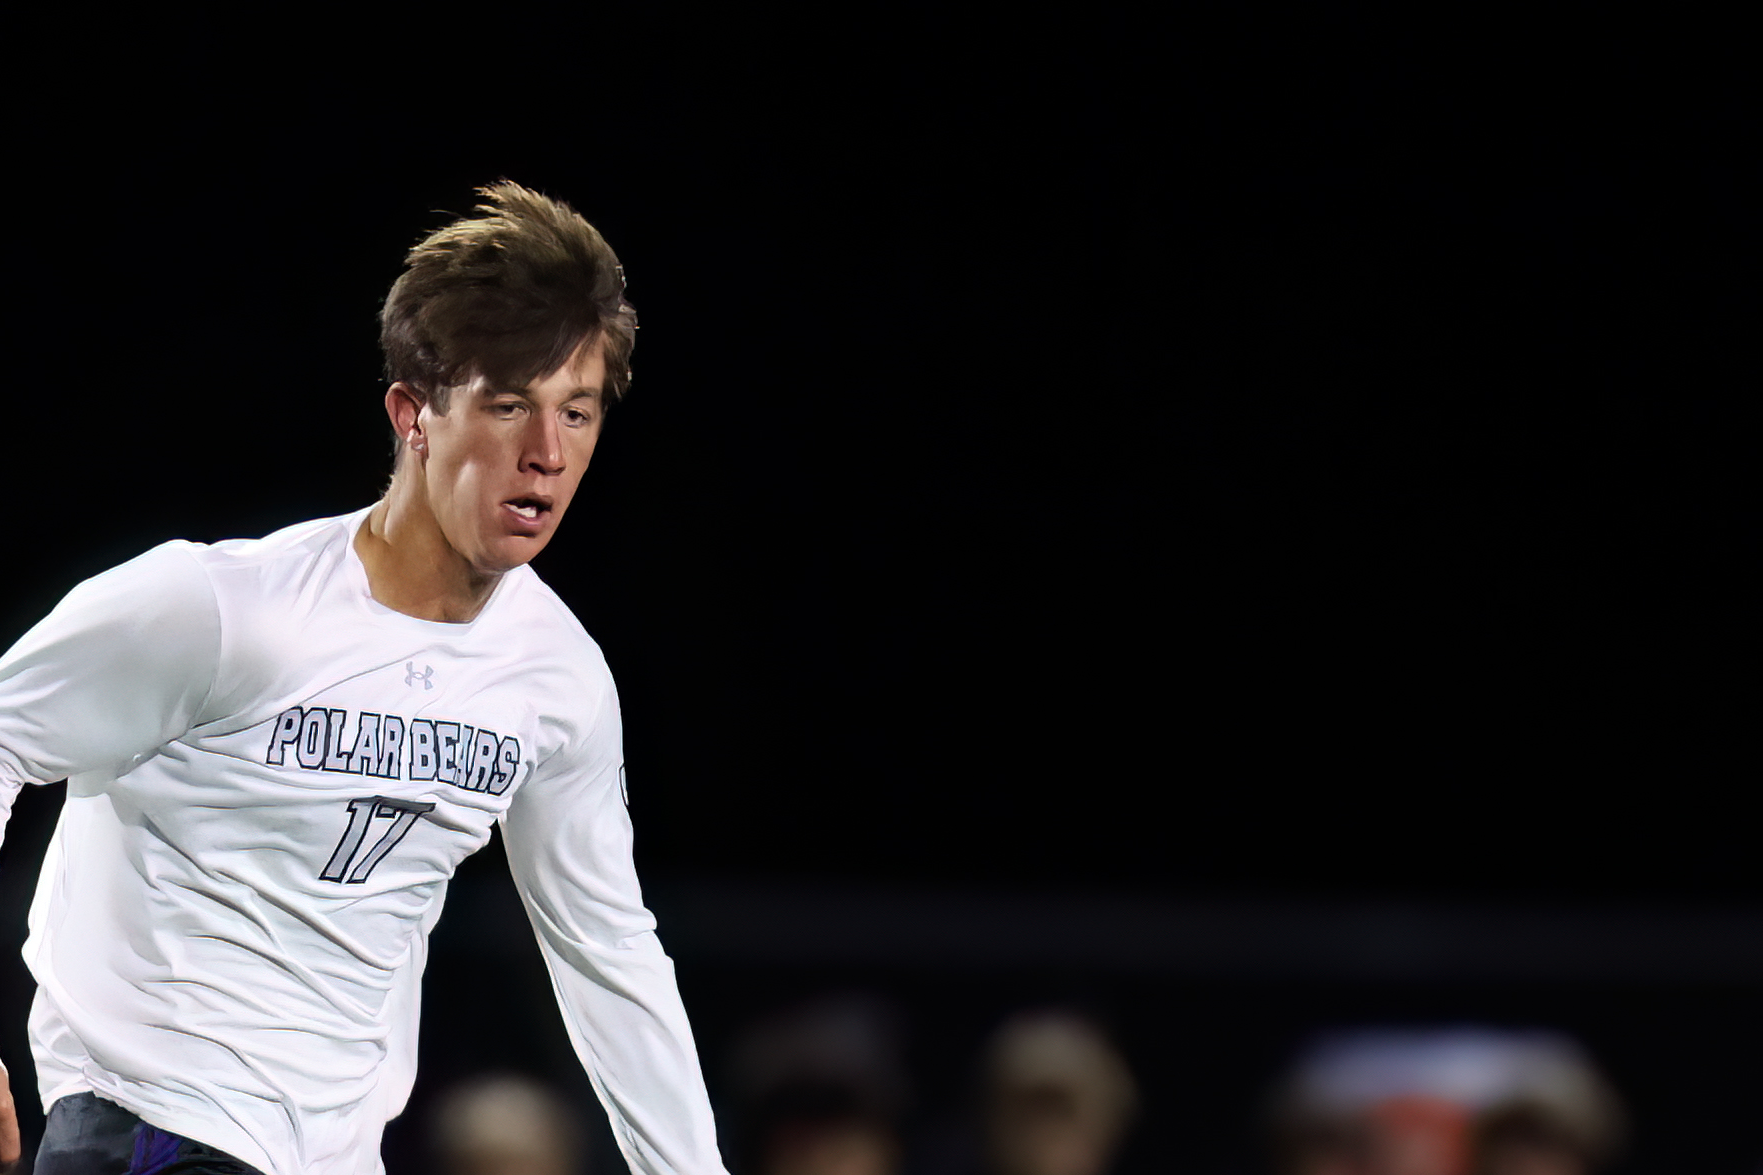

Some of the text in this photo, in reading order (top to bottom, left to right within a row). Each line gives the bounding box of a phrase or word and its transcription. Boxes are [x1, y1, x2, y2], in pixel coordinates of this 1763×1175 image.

[267, 707, 520, 796] POLAR BEARS
[319, 796, 436, 883] 17
